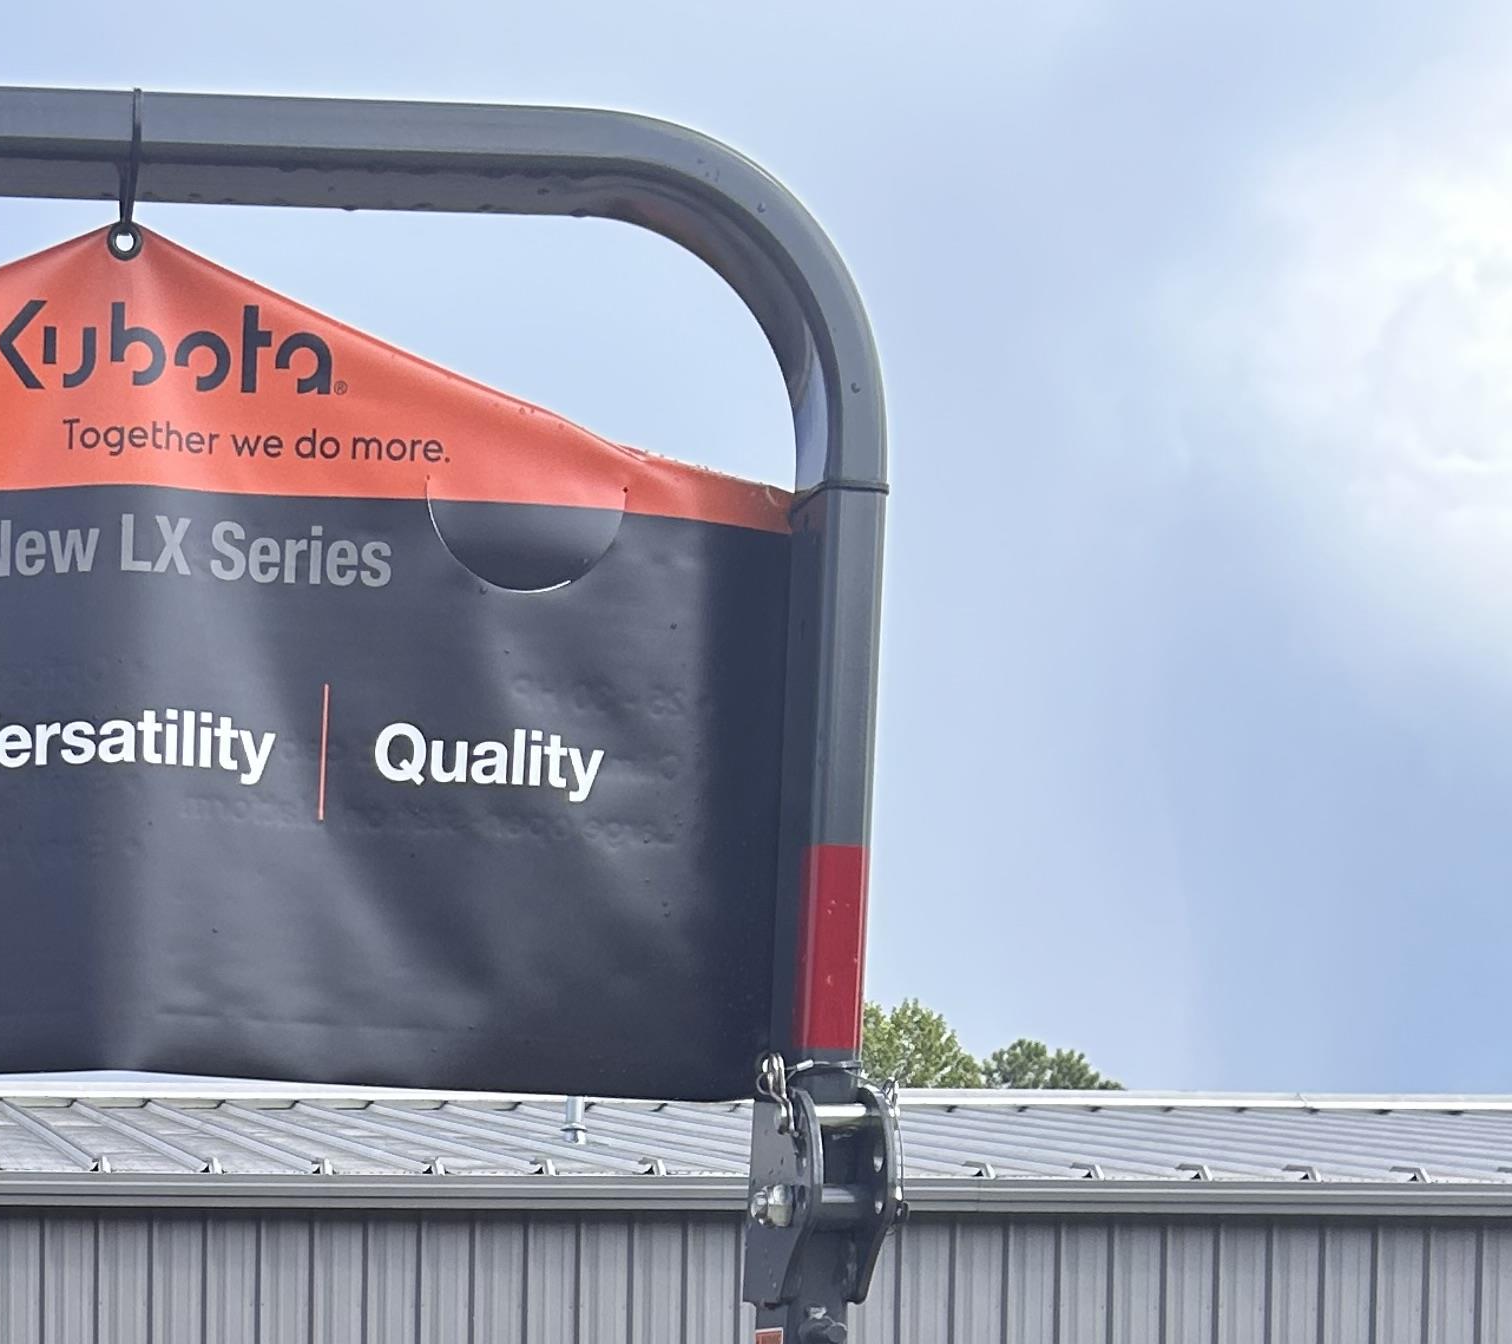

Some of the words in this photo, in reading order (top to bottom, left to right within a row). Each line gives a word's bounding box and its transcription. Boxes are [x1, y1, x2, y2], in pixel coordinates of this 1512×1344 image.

[62, 418, 220, 458] Together
[230, 434, 284, 458] we
[295, 428, 341, 460] do
[351, 438, 451, 464] more.
[120, 513, 192, 576] LX
[210, 520, 393, 588] Series
[373, 722, 605, 802] Quality
